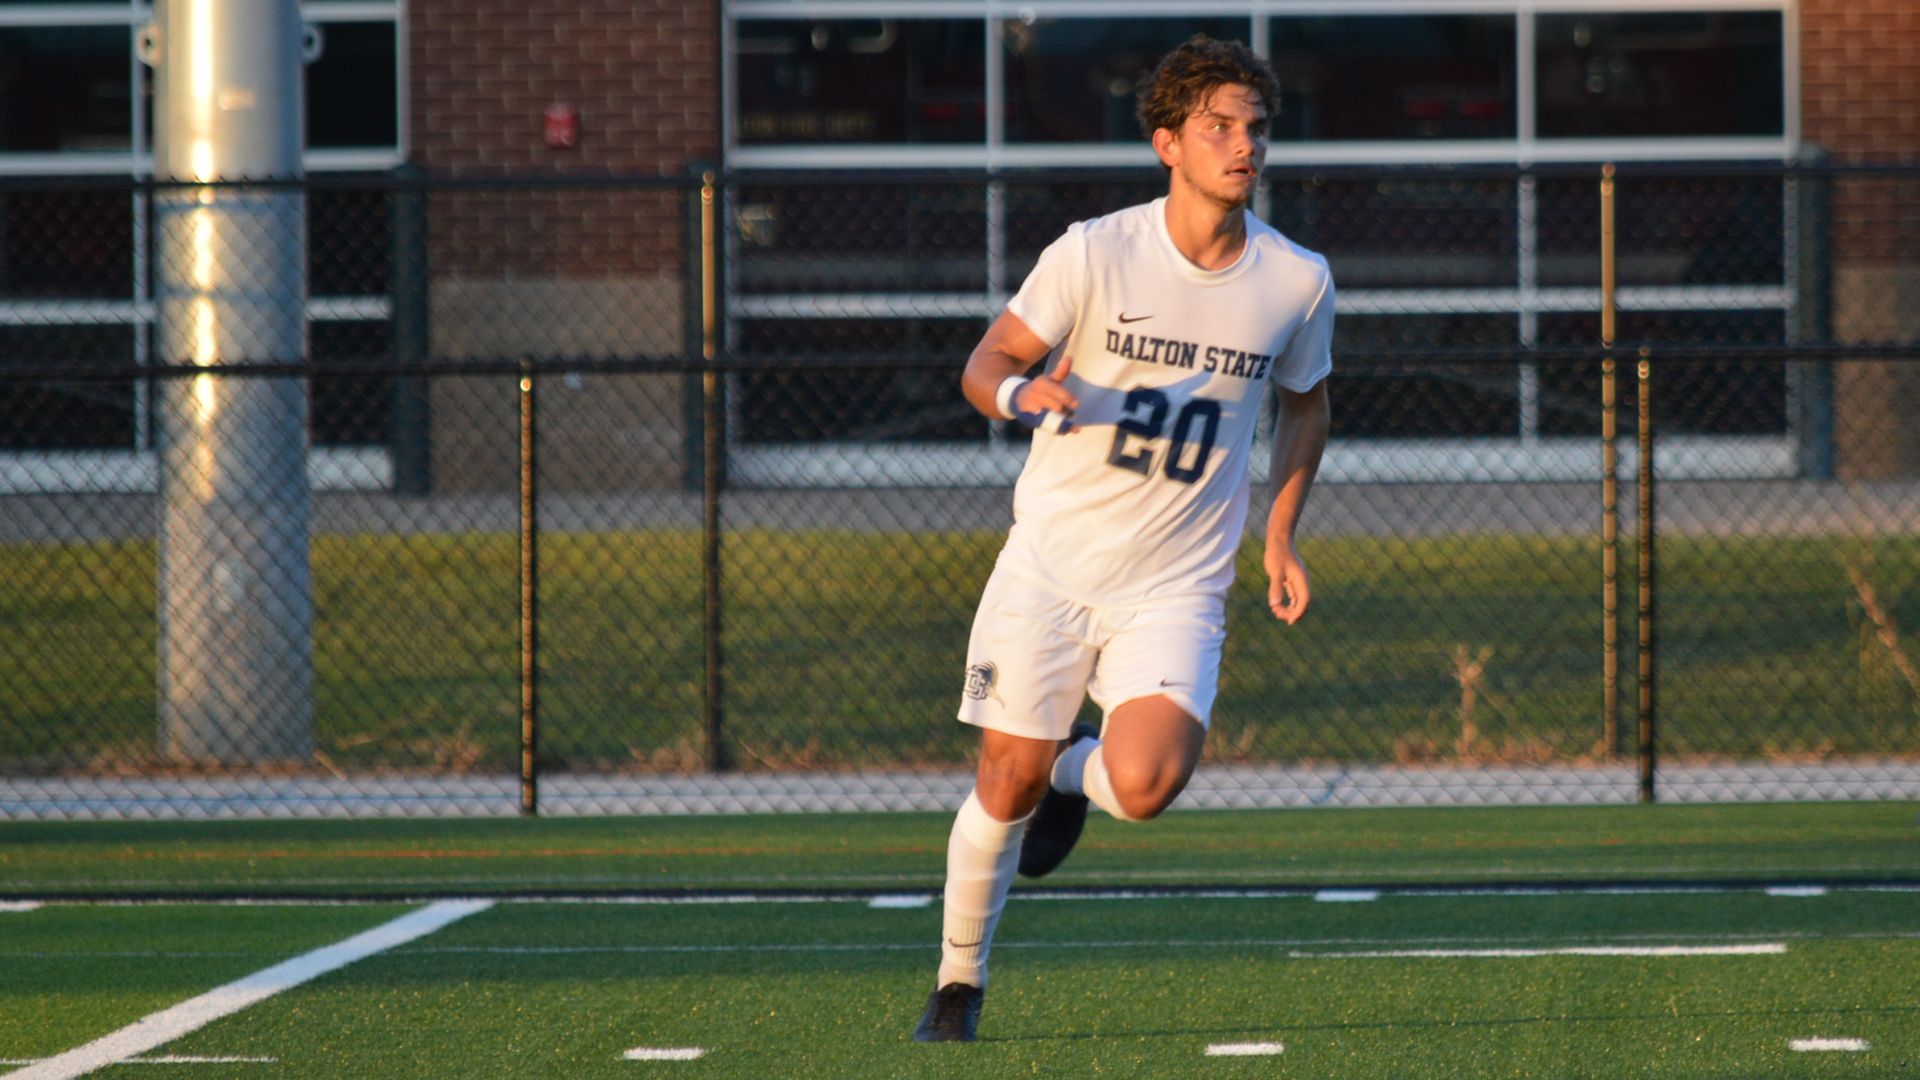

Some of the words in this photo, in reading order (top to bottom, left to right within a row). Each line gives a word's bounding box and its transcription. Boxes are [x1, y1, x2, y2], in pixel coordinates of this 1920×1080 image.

[1106, 329, 1198, 369] DALTON
[1203, 346, 1271, 380] STATE
[1105, 385, 1222, 484] 20
